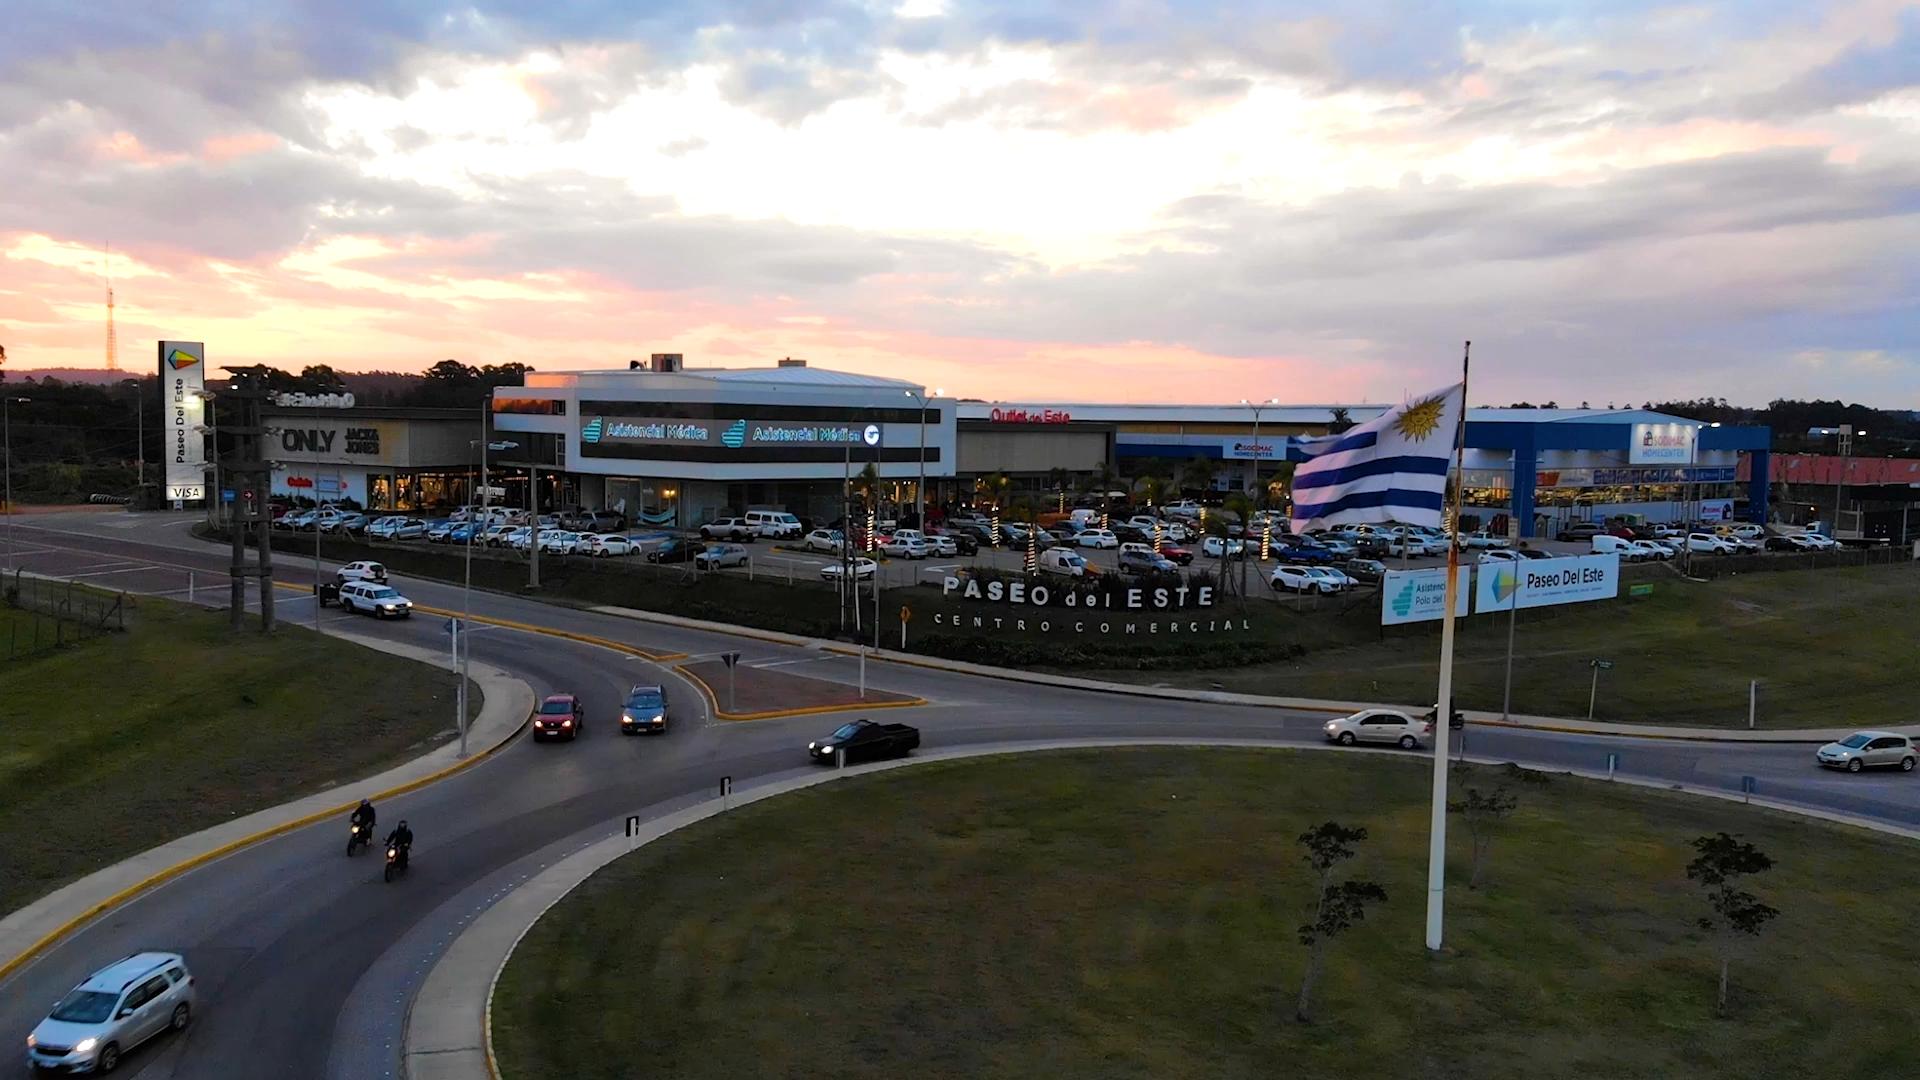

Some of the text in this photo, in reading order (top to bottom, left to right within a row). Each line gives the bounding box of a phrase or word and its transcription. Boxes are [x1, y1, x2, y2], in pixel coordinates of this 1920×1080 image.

[175, 378, 185, 463] Paseo Del Este
[991, 408, 1027, 424] Outlet
[1044, 410, 1070, 424] Este
[606, 423, 708, 440] Asistencial Médica
[752, 426, 861, 442] Asistencial Médica
[282, 429, 336, 452] ONLY
[344, 441, 379, 454] JONES
[174, 488, 199, 498] VISA
[1527, 568, 1603, 589] Paseo Del Este
[943, 576, 1213, 608] PASEO del ESTE
[1416, 581, 1446, 593] Asistenci
[1415, 596, 1430, 606] Polo
[934, 614, 1250, 634] CENTRO COMERCIAL
